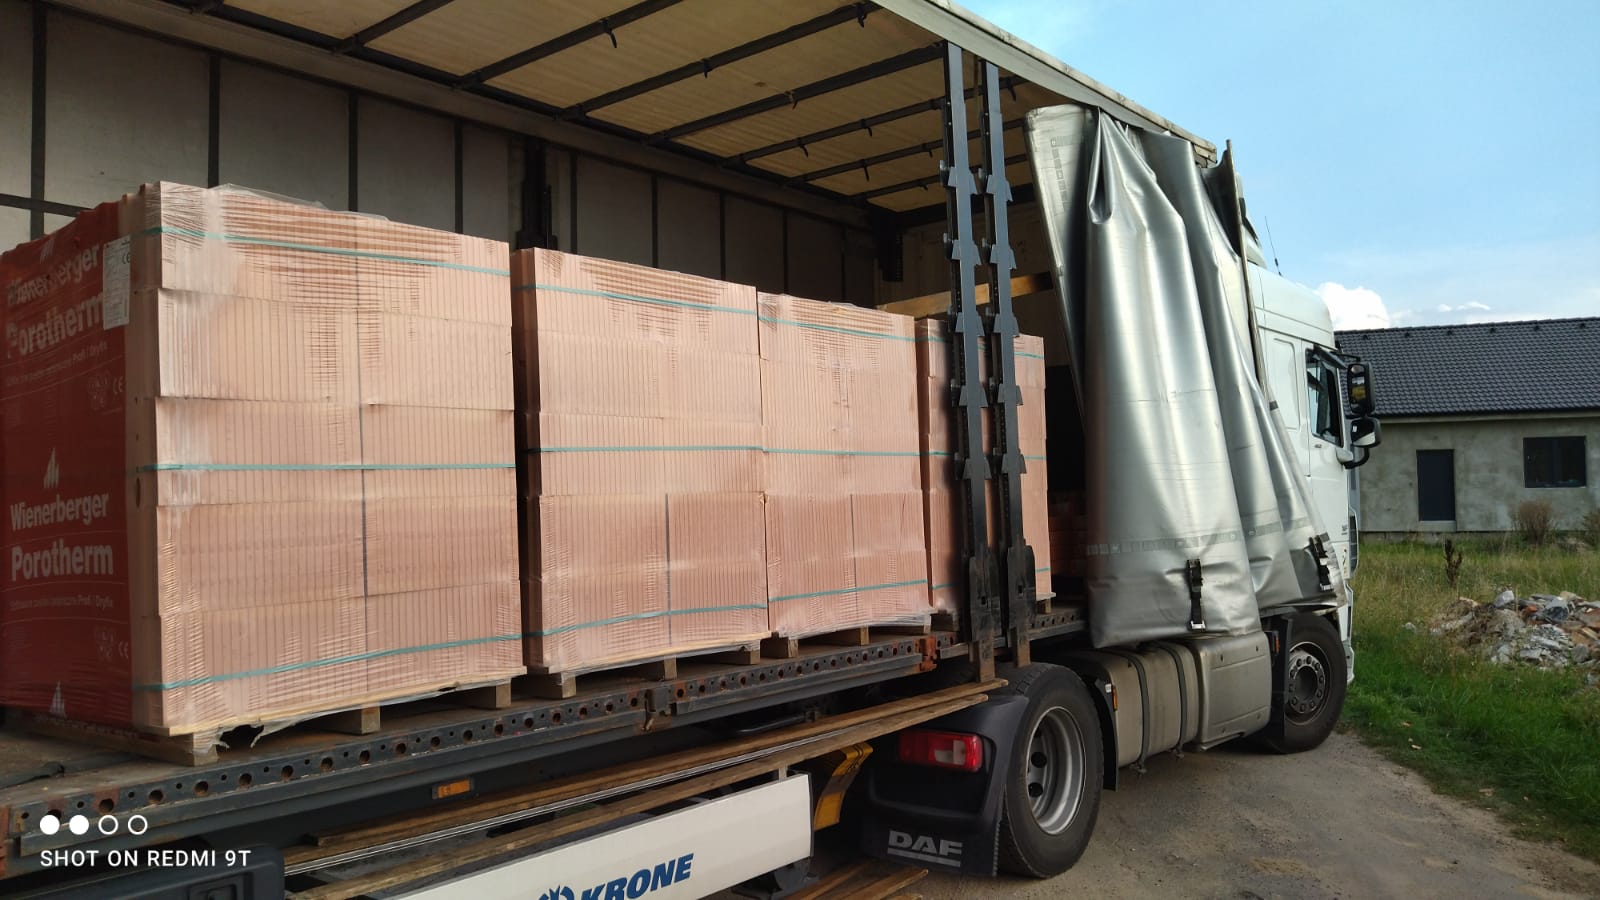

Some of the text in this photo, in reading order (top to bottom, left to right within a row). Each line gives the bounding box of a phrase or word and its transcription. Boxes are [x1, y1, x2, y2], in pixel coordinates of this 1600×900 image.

[7, 291, 103, 359] Porotherm
[10, 493, 110, 531] Wienerberger
[11, 538, 114, 582] Porotherm
[888, 829, 963, 856] DAF
[573, 853, 694, 900] KRONE
